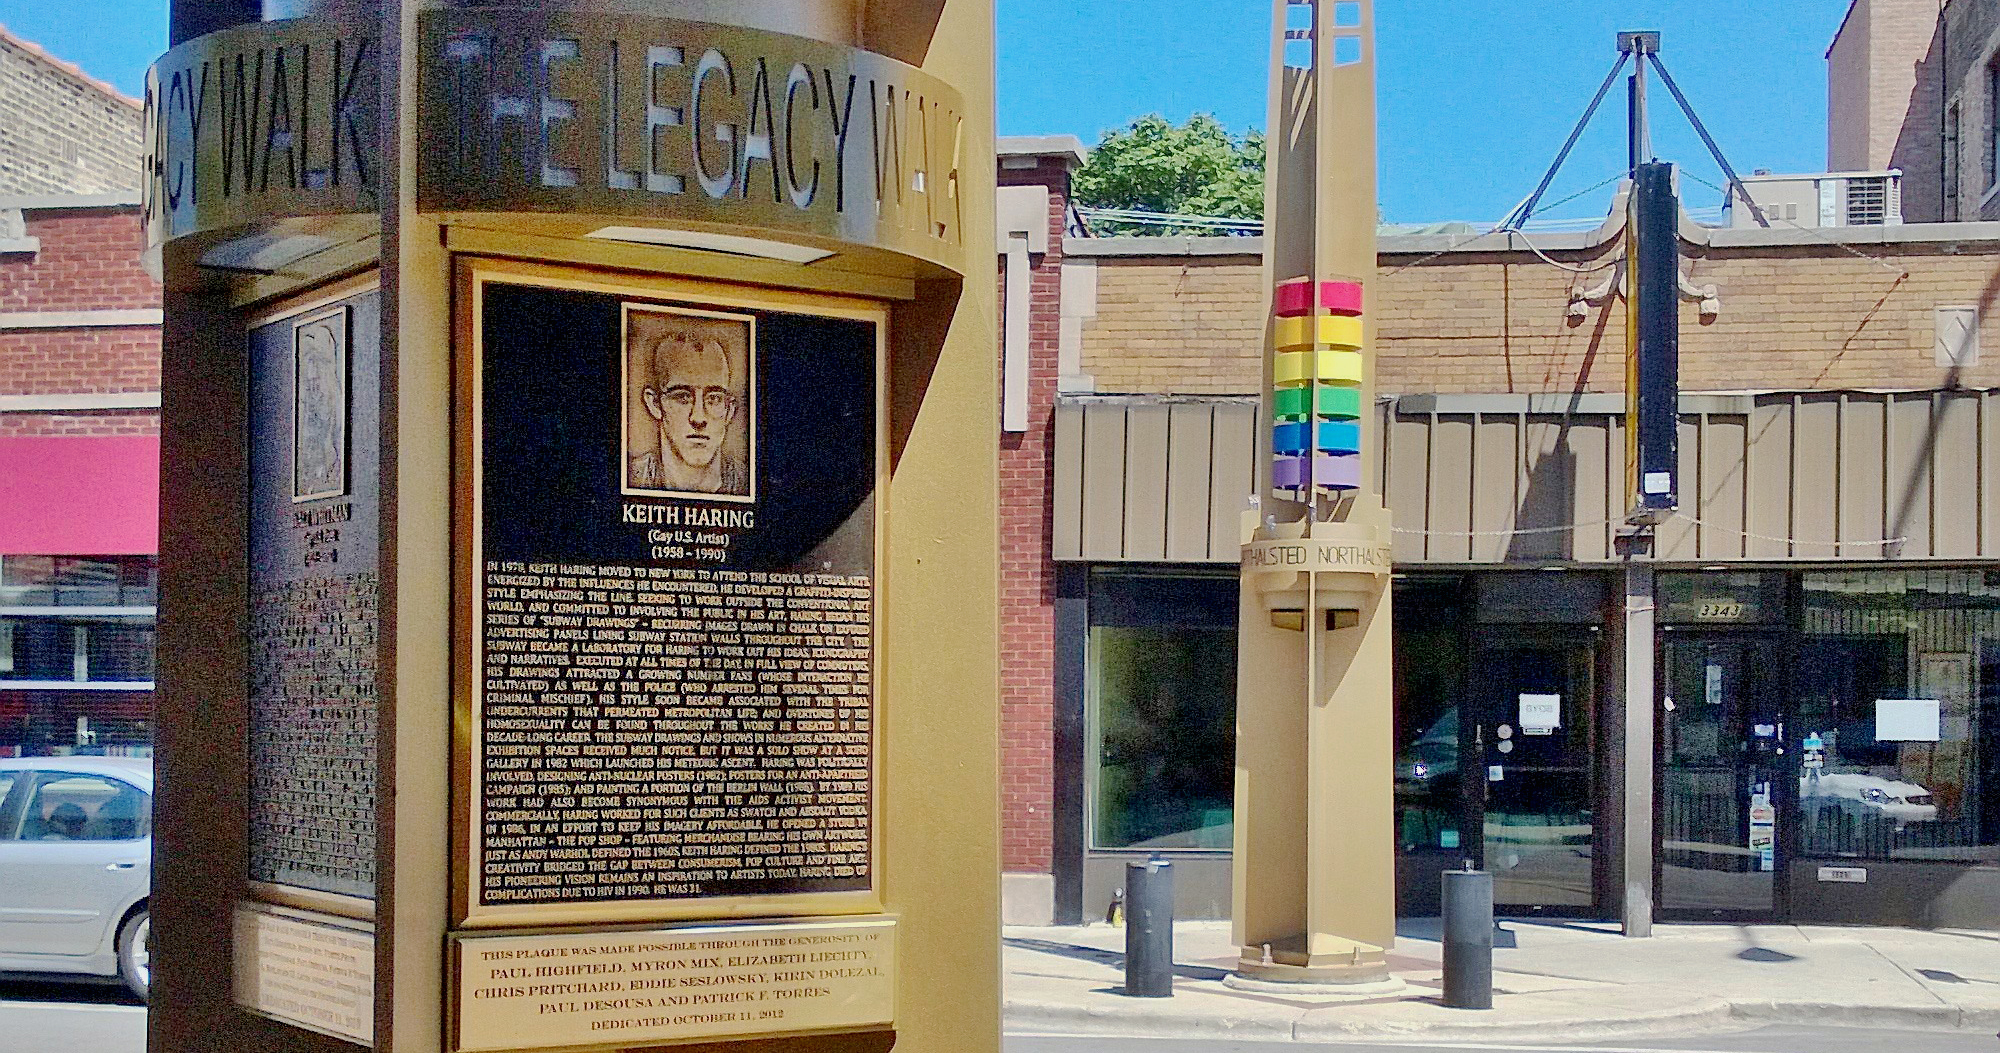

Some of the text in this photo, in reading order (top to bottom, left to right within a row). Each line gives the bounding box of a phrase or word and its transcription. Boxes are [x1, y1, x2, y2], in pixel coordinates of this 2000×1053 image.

[219, 39, 369, 197] WALK
[445, 36, 582, 188] THE
[606, 39, 857, 213] LEGACY
[622, 503, 754, 529] KEITH HARING
[648, 529, 730, 547] (Gay U.S. Artist)
[651, 546, 684, 560] (1958
[695, 548, 726, 562] 1990)
[487, 562, 497, 571] IN
[529, 563, 557, 574] KEITH
[560, 564, 596, 575] HARING
[599, 566, 631, 576] MOVED
[634, 567, 646, 577] TO
[543, 578, 555, 588] BY
[558, 578, 576, 588] THE
[637, 581, 650, 591] HE
[487, 589, 516, 599] STYLE
[521, 590, 583, 601] EMPHASIZING
[588, 592, 607, 602] THE
[529, 603, 549, 613] AND
[553, 604, 609, 615] COMMITTED
[614, 605, 626, 615] TO
[630, 606, 677, 617] INVOLVING
[1701, 604, 1740, 617] 3343
[523, 616, 536, 625] OF
[487, 628, 549, 639] ADVERTISING
[554, 629, 588, 640] PANELS
[593, 630, 624, 641] LINING
[628, 631, 665, 642] SUBWAY
[670, 632, 707, 643] STATION
[487, 641, 527, 652] SUBWAY
[531, 642, 568, 652] BECAME
[571, 643, 578, 653] A
[645, 644, 662, 654] FOR
[487, 655, 657, 667] AND AT ALL
[487, 667, 681, 680] HIS DRAWINGS ATTRACTED A GROWING
[555, 681, 615, 692] AS WELL AS
[487, 693, 534, 703] CRIMINAL
[600, 694, 615, 704] HIS
[621, 695, 649, 704] STYLE
[574, 707, 599, 717] THAT
[487, 720, 565, 729] HOMOSEXUALITY
[572, 720, 591, 730] CAN
[598, 720, 609, 730] BE
[616, 733, 653, 743] SUBWAY
[487, 758, 528, 768] GALLERY
[532, 758, 541, 768] IN
[571, 758, 602, 768] WHICH
[574, 784, 594, 794] AND
[597, 784, 639, 794] PAINTING
[551, 797, 575, 807] ALSO
[563, 809, 598, 819] HARING
[601, 809, 641, 819] WORKED
[486, 822, 614, 834] IN AN TO
[486, 835, 622, 847] MANHATTAN THE POP SHOP
[485, 847, 651, 860] JUST AS ANDY WARHOL DEFINED THE
[485, 859, 675, 873] CREATIVITY BRIDGED THE GAP BETWEEN
[485, 876, 501, 886] HIS
[565, 873, 595, 884] VISION
[642, 872, 654, 882] AN
[485, 883, 688, 899] COMPLICATIONS DUE TO HIV IN 1990. WAS
[481, 951, 513, 961] THIS
[516, 948, 568, 959] PLAQUE
[571, 947, 596, 955] WAS
[600, 945, 636, 954] MADE
[638, 942, 697, 953] POSSIBLE
[699, 940, 759, 950] THROUGH
[762, 938, 785, 946] THE
[789, 935, 860, 945] GENEROSITY
[631, 960, 687, 972] MYRON
[690, 957, 723, 969] MIX,
[728, 953, 806, 966] ELIZABETH
[474, 986, 524, 999] CHRIS
[528, 982, 625, 996] PRITCHARD,
[630, 978, 676, 990] EDDIE
[680, 973, 769, 987] SESLOWSKY,
[774, 970, 815, 982] KIRIN
[539, 987, 831, 1014] PAUL DESOUSA AND PATRICK F. TORRES
[591, 1016, 670, 1031] DEDICATED
[673, 1013, 736, 1025] OCTOBER
[758, 1009, 784, 1019] 2012
